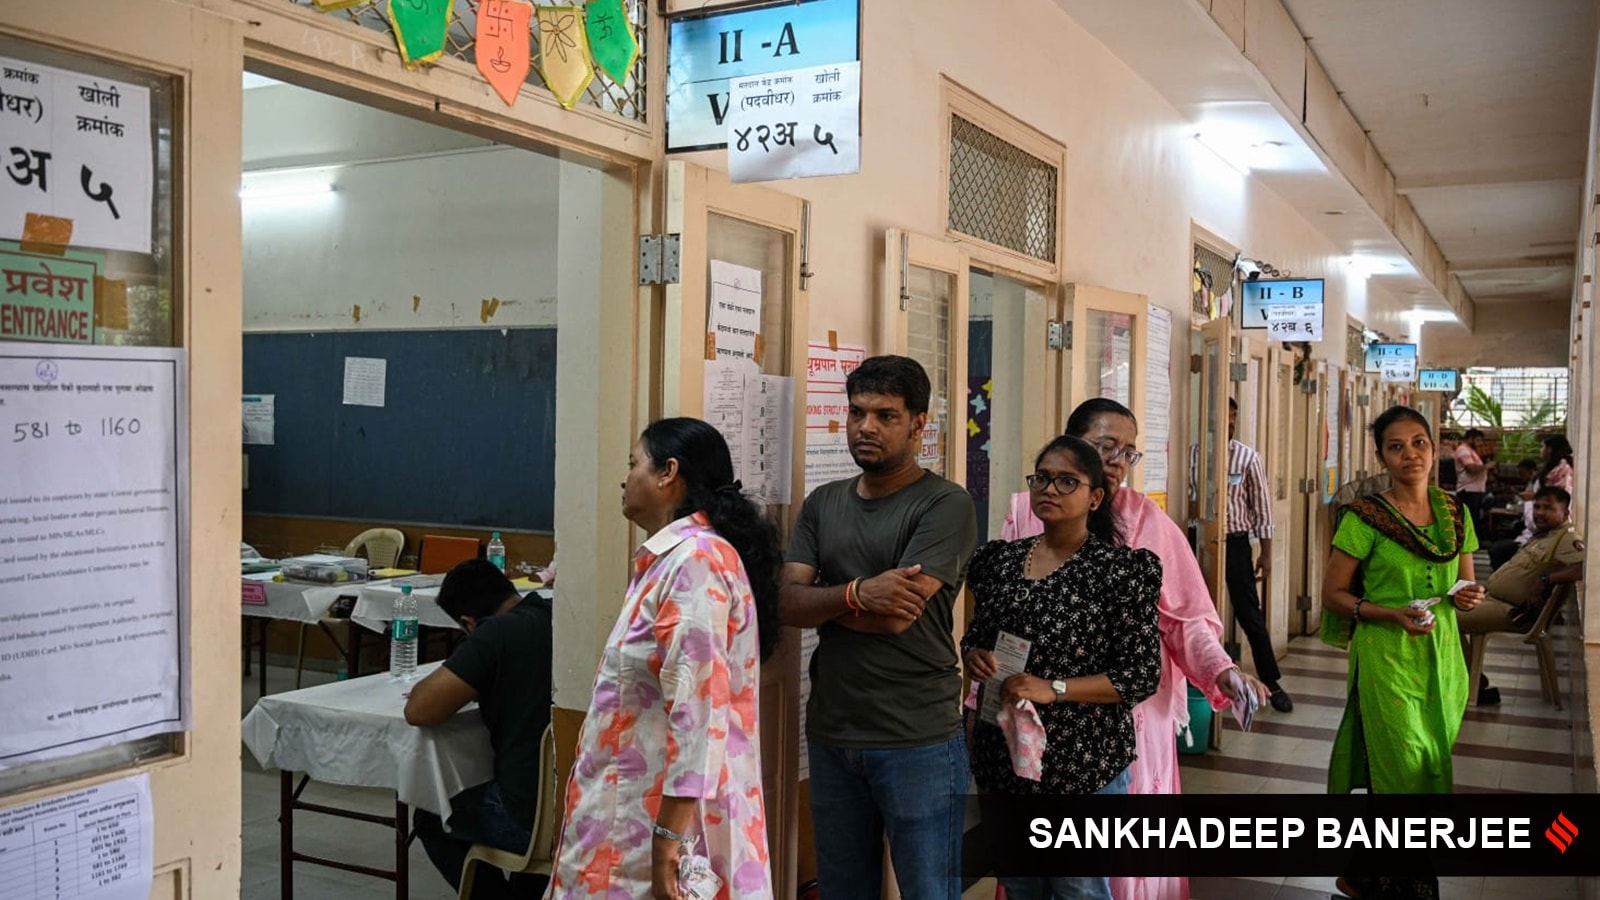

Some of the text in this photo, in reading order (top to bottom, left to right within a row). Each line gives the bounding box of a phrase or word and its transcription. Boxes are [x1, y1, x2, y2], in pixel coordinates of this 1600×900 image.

[718, 29, 744, 64] II
[3, 67, 40, 84] क्रमांक
[814, 68, 841, 84] खोली
[78, 82, 120, 108] खोली
[740, 89, 795, 111] (पदवीधर)
[812, 90, 842, 104] क्रमांक
[76, 115, 124, 138] क्रमांक
[734, 122, 838, 154] ४२अ ५
[5, 146, 120, 220] अ ५
[2, 262, 88, 301] प्रवेश
[1260, 287, 1272, 300] II
[1292, 286, 1304, 299] B
[1, 304, 88, 341] ENTRANCE
[1304, 322, 1314, 336] ६
[12, 416, 141, 443] 581 to 1160
[922, 443, 937, 457] EXIT
